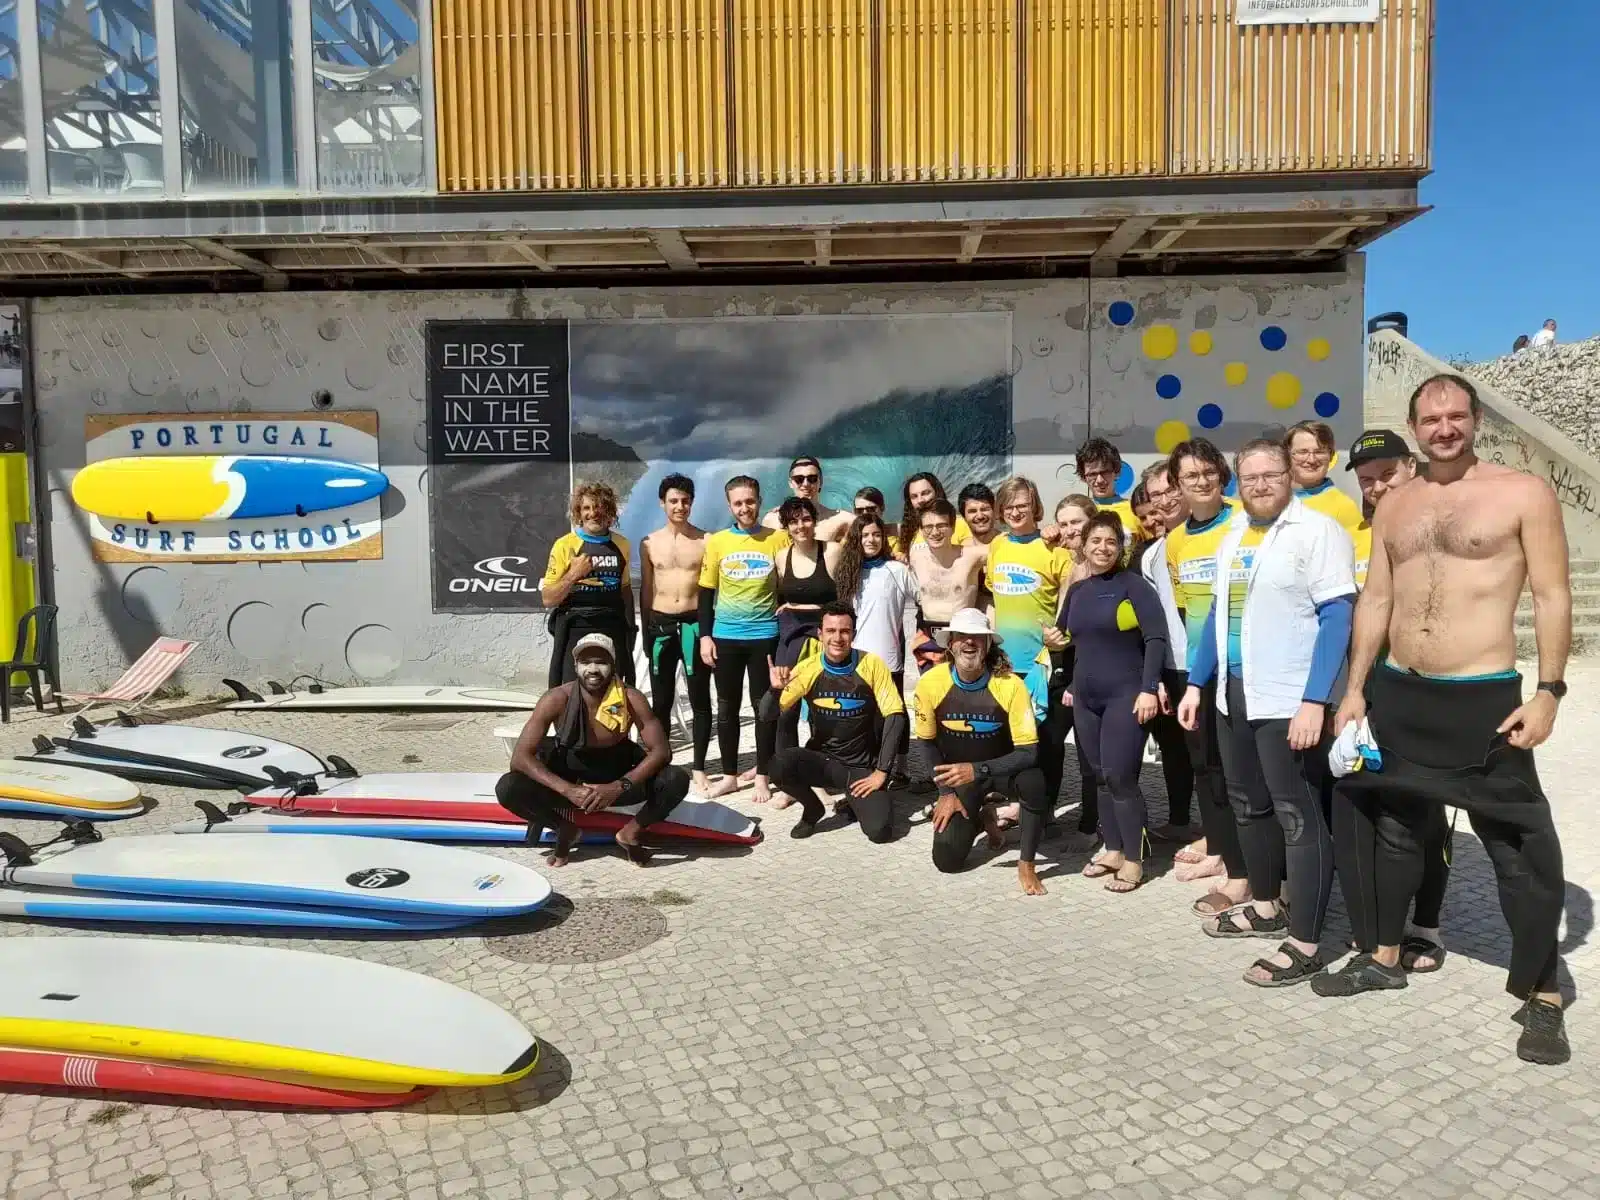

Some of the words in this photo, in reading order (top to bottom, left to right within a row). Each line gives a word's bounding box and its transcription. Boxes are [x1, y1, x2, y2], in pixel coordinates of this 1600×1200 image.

[443, 343, 525, 365] FIRST
[461, 372, 549, 394] NAME
[445, 401, 472, 423] IN
[483, 401, 540, 423] THE
[130, 424, 333, 449] PORTUGAL
[444, 429, 550, 451] WATER
[111, 523, 196, 552] SURF
[228, 517, 361, 551] SCHOOL
